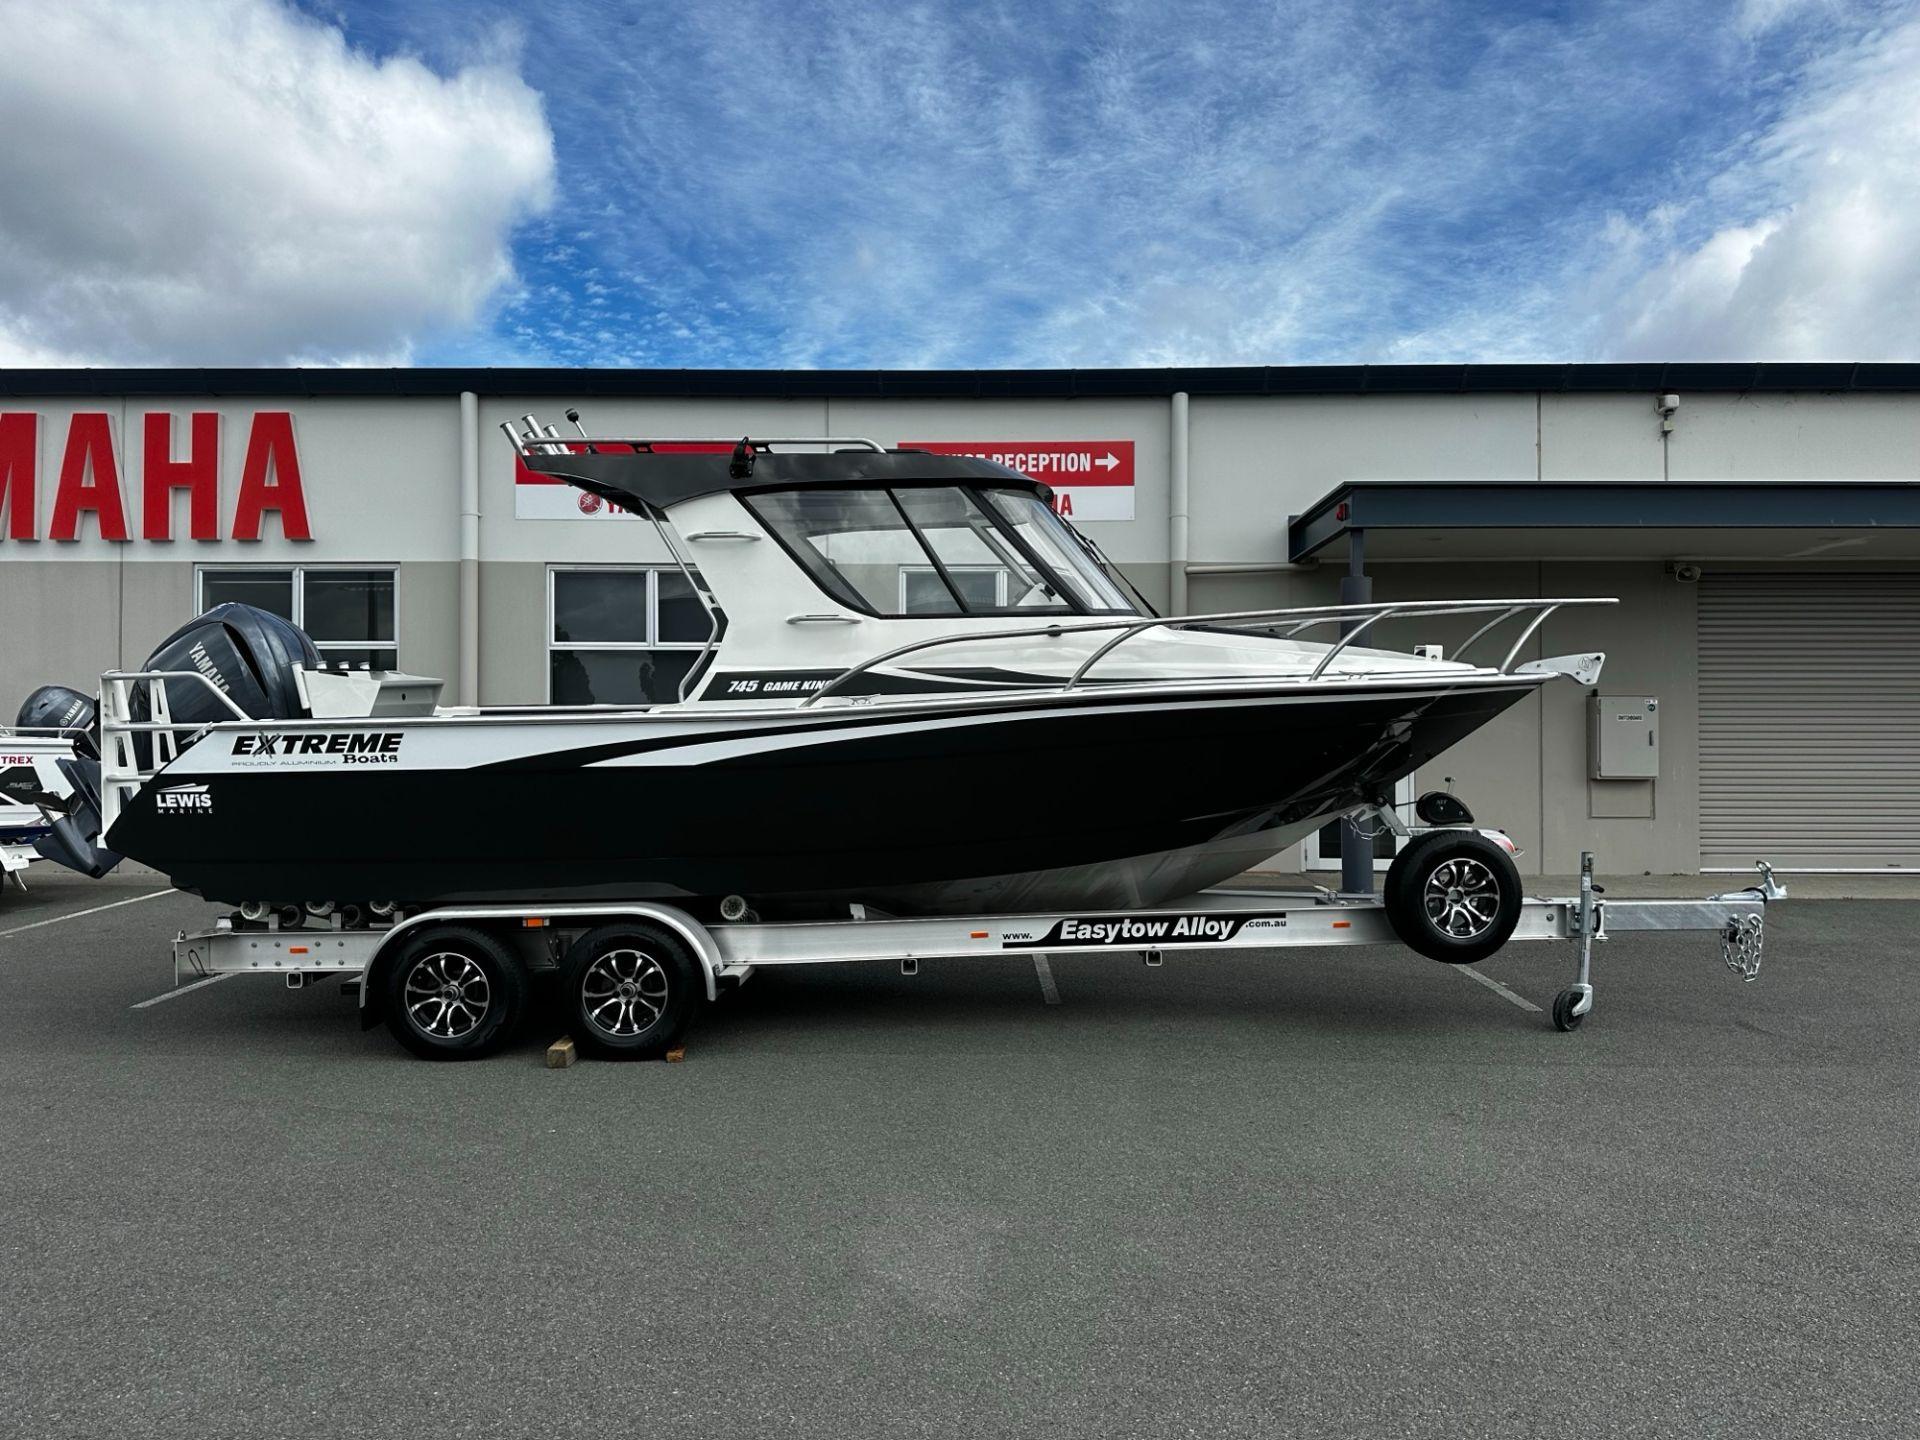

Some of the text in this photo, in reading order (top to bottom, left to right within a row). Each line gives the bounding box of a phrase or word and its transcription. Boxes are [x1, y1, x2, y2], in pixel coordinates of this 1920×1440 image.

[727, 680, 760, 692] 745
[763, 680, 801, 692] GAME
[231, 732, 404, 756] EXTREME
[1, 756, 34, 764] TREX
[342, 753, 398, 764] Boats
[1060, 919, 1168, 943] Easytow
[1171, 916, 1235, 940] Alloy
